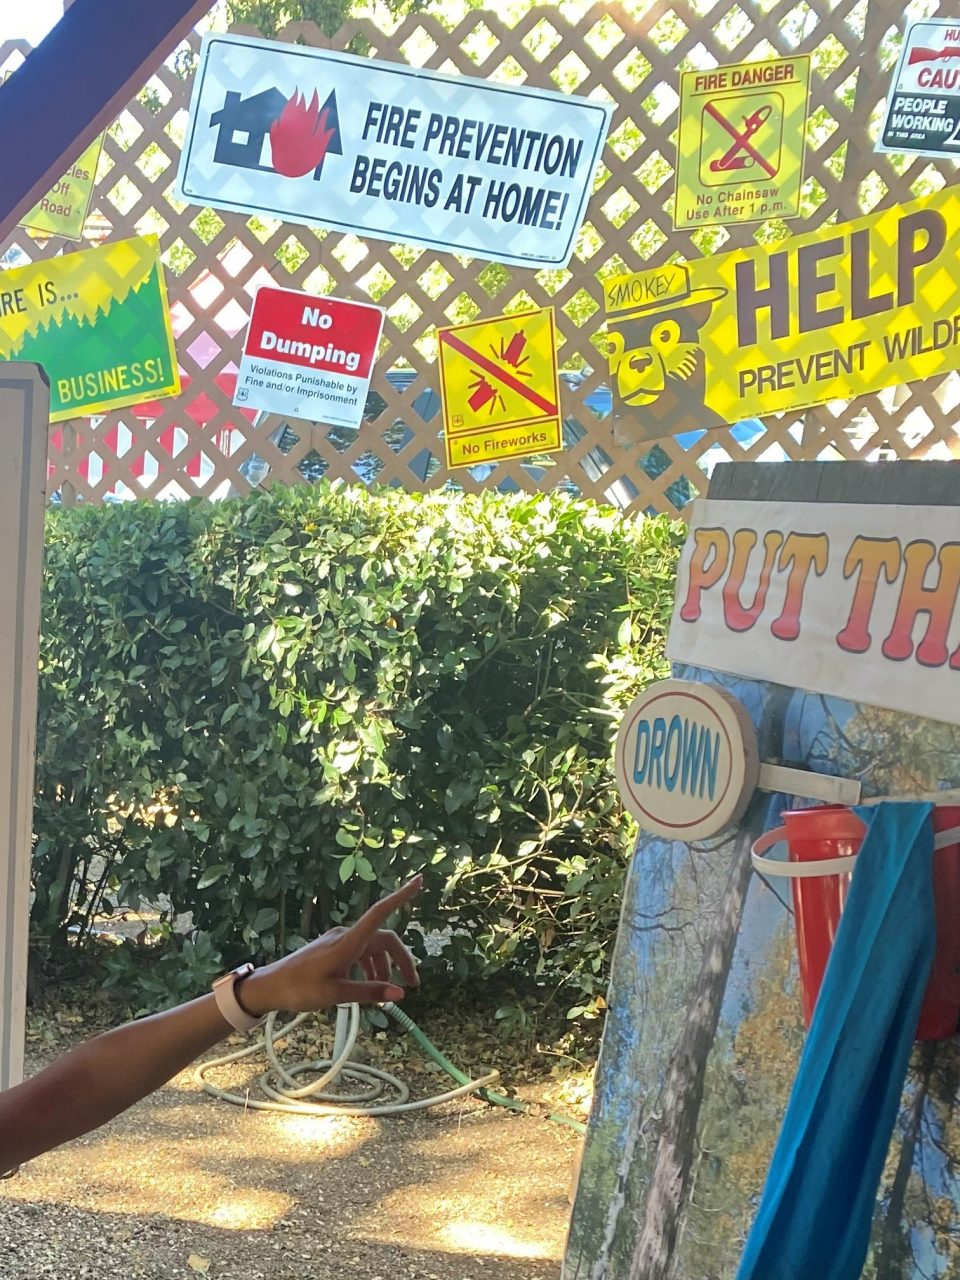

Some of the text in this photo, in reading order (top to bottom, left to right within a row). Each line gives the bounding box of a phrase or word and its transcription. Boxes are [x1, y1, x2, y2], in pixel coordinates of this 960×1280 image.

[695, 63, 795, 92] FIRE DANGER
[917, 67, 960, 89] CAU
[894, 96, 948, 115] PEOPLE
[891, 113, 954, 133] WORKING
[910, 132, 926, 140] AREA
[361, 101, 584, 179] FIRE PREVENTION
[51, 181, 71, 196] Off
[349, 154, 570, 231] BEGINS AT HOME!
[696, 187, 780, 206] No Chainsaw
[40, 198, 72, 217] Road
[686, 201, 787, 221] Use After 1 p.m.
[607, 273, 675, 307] SMOKEY
[735, 208, 947, 348] HELP
[38, 281, 79, 307] IS...
[301, 306, 333, 329] No
[260, 330, 361, 372] Dumping
[57, 357, 165, 404] BUSINESS!
[250, 364, 358, 395] Violations Punishable by
[739, 340, 871, 398] PREVENT
[245, 376, 358, 406] Fine and/or Imprisonment
[462, 432, 547, 456] No Fireworks
[680, 526, 960, 671] PUT TH
[633, 713, 721, 802] DROWN
